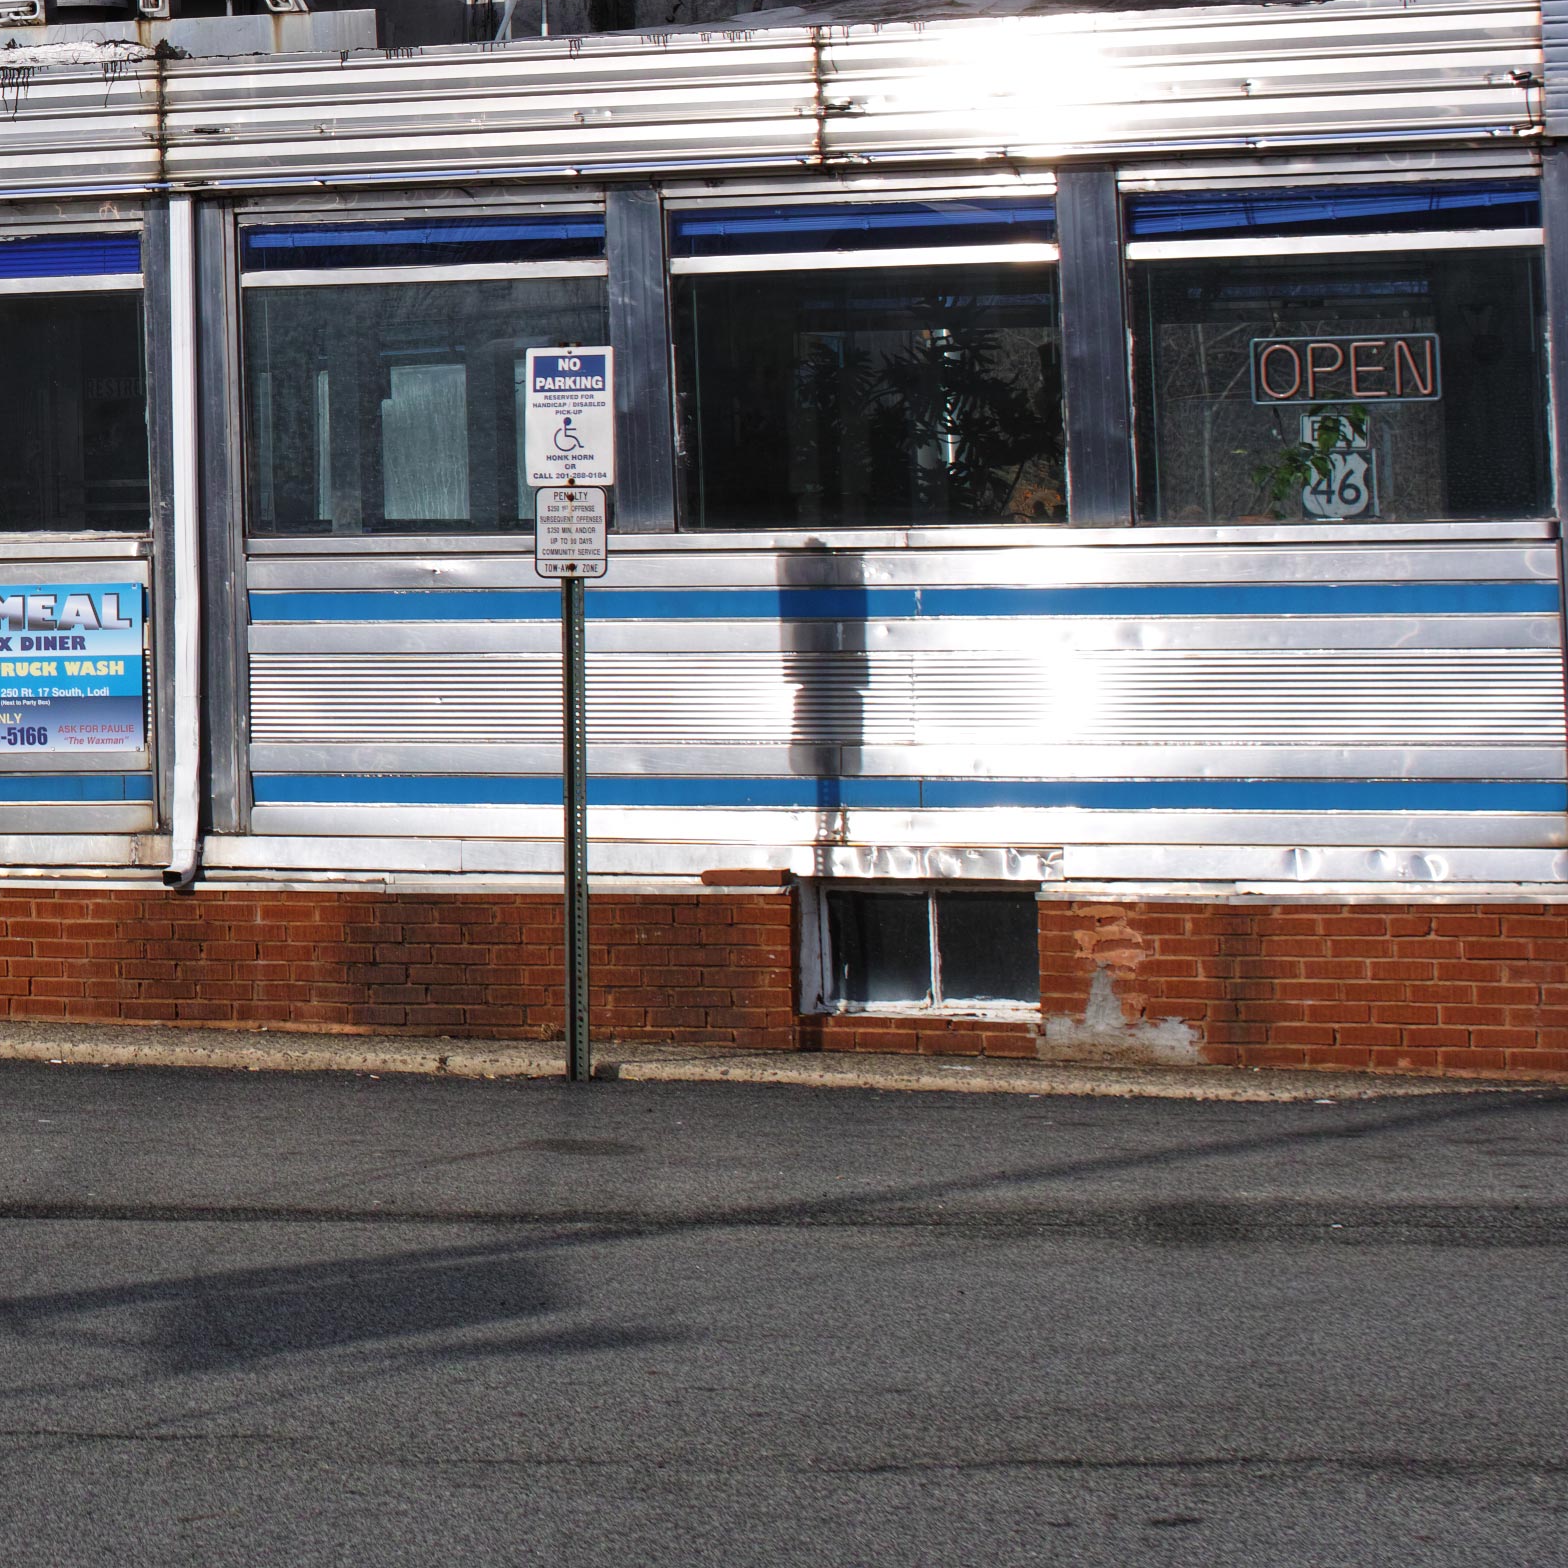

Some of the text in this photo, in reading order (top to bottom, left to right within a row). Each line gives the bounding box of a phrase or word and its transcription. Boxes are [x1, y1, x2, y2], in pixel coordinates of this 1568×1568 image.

[558, 357, 581, 372] NO
[1260, 340, 1434, 400] OPEN
[535, 375, 603, 391] PARKING
[1310, 468, 1361, 505] 46
[553, 491, 588, 501] PENLTY
[545, 564, 598, 572] TOW-AWY ZONE
[20, 635, 87, 651] DINER
[64, 661, 125, 676] WASH
[0, 686, 110, 699] 250 Rt. 17 South, Lodi
[58, 724, 135, 734] ASK FOR PAULIE
